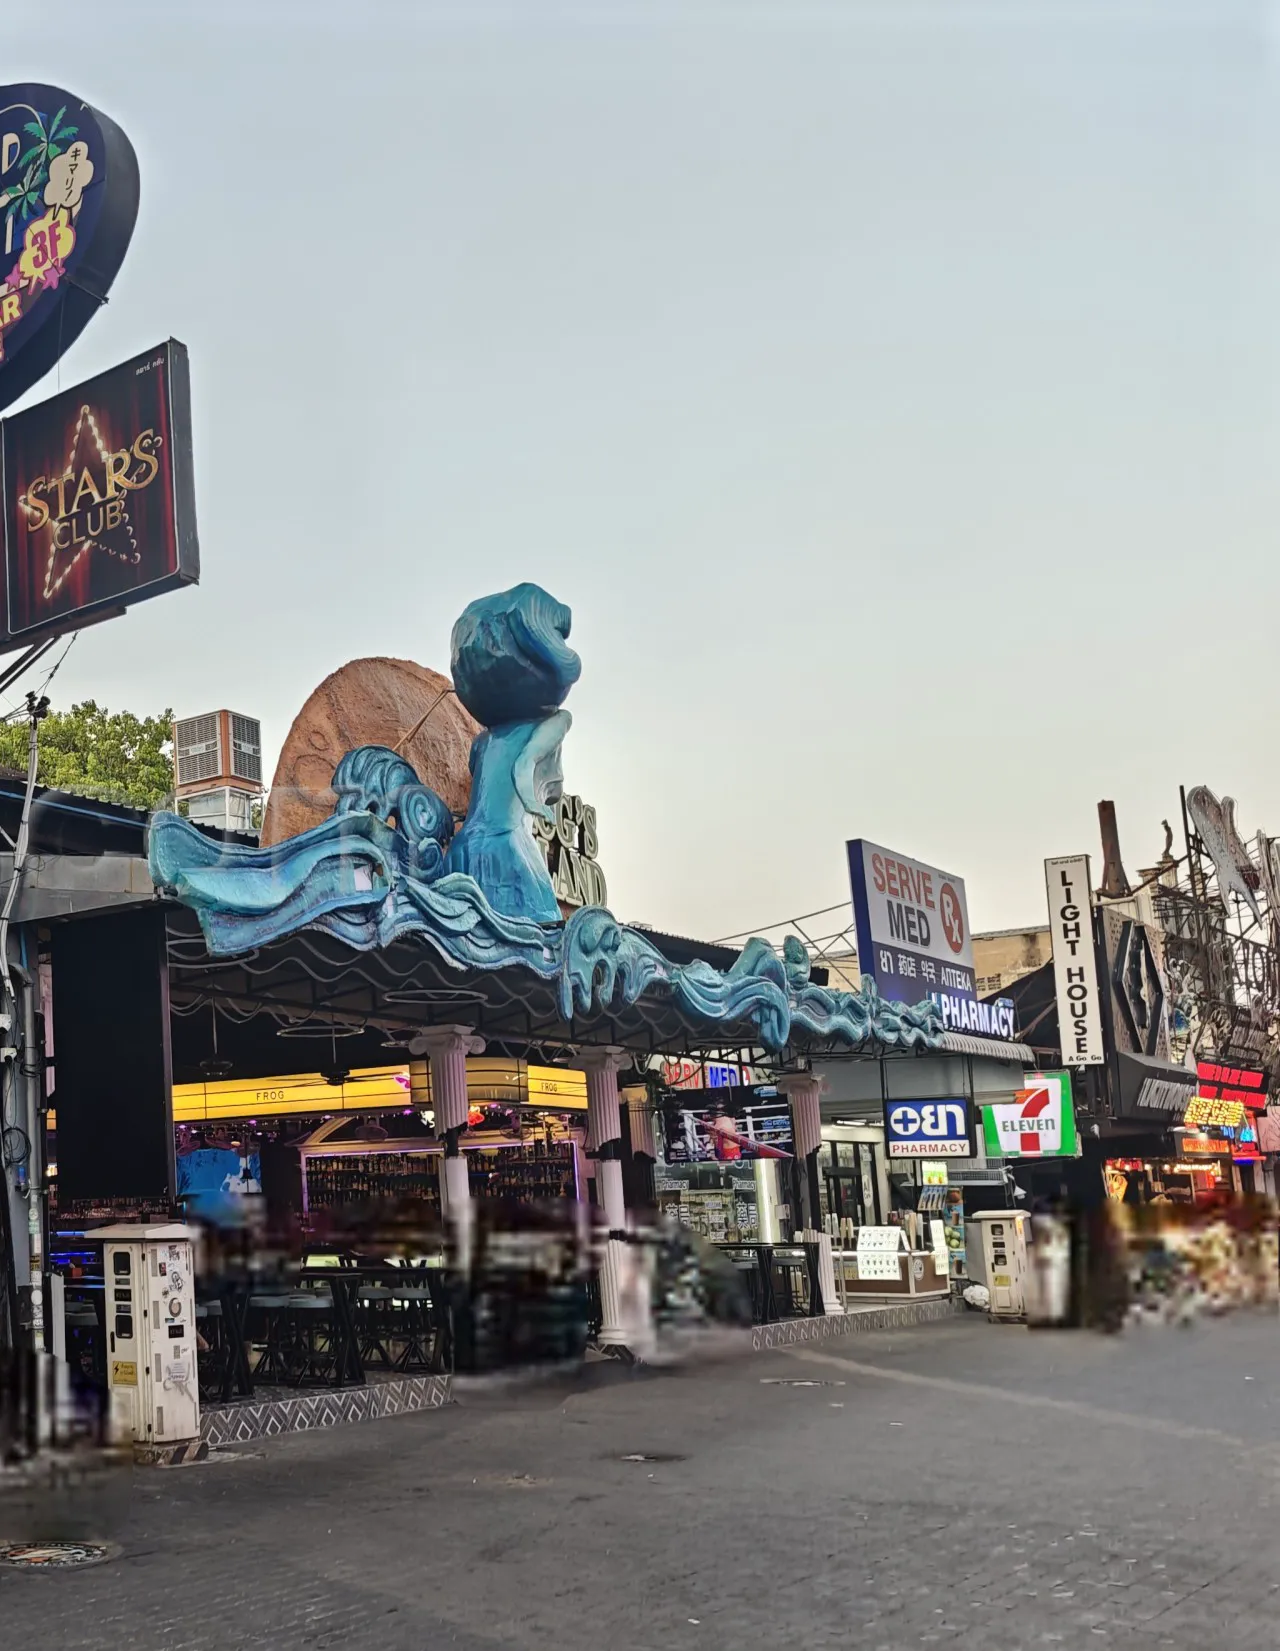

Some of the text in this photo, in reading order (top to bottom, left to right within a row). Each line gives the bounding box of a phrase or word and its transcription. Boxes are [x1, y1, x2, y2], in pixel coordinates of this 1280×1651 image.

[31, 220, 63, 269] 3F
[26, 429, 159, 532] STARS
[53, 502, 122, 550] CLUB
[871, 853, 936, 912] SERVE
[886, 899, 931, 947] MED
[1060, 870, 1081, 956] LIGHT
[880, 950, 894, 975] ยา
[941, 966, 973, 992] АПТЕКА
[942, 993, 1015, 1037] PHARMACY
[1066, 966, 1088, 1054] HOUSE
[256, 1091, 285, 1101] FROG
[541, 1082, 558, 1093] FROG
[663, 1062, 709, 1088] SERV
[921, 1104, 966, 1136] ยา
[892, 1143, 967, 1154] PHARMACY
